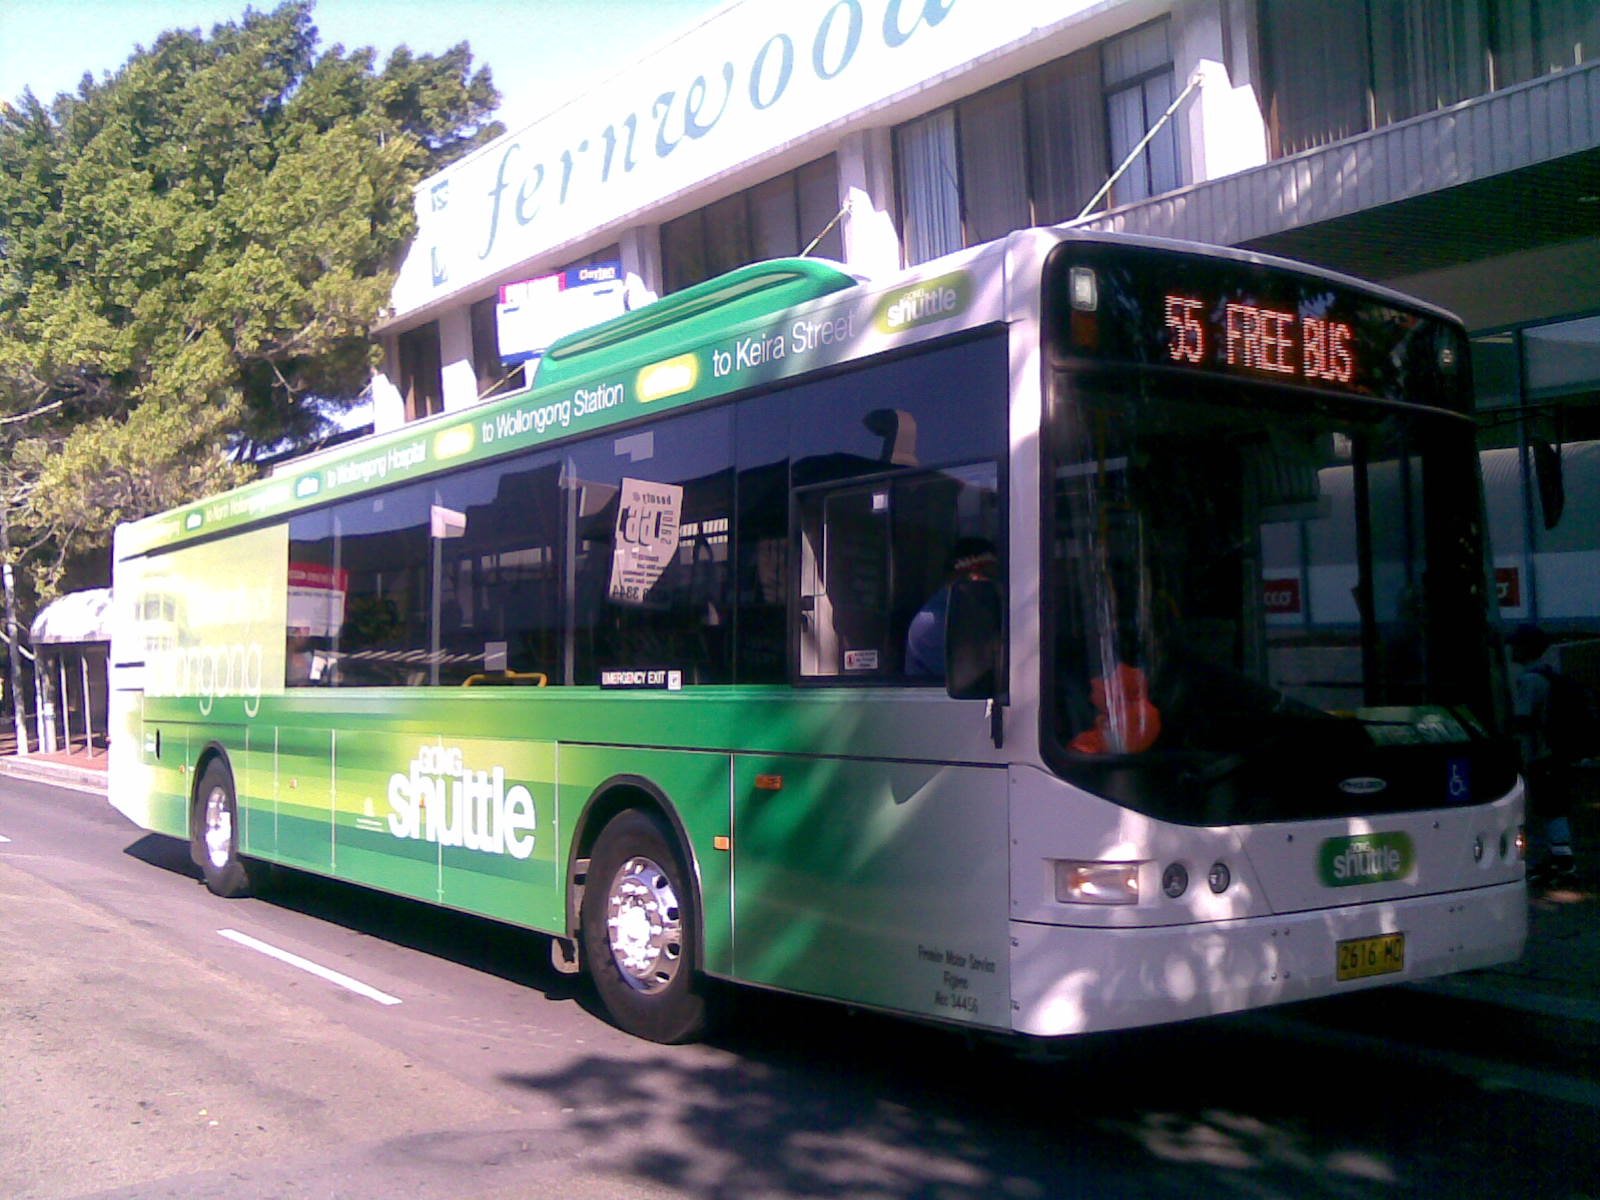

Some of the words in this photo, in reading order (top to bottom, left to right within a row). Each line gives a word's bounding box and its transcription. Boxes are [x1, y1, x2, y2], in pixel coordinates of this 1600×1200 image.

[887, 286, 957, 328] shuttle
[713, 348, 732, 378] to
[735, 334, 785, 371] Keira
[791, 310, 856, 354] Street
[1165, 295, 1204, 363] 55
[1226, 303, 1295, 374] FREE
[1303, 317, 1352, 383] BUS
[482, 422, 494, 443] to
[496, 400, 571, 433] Wollongong
[574, 383, 624, 417] Station
[647, 670, 666, 684] EXIT
[387, 758, 537, 860] shuttle
[1333, 845, 1401, 879] shuttle
